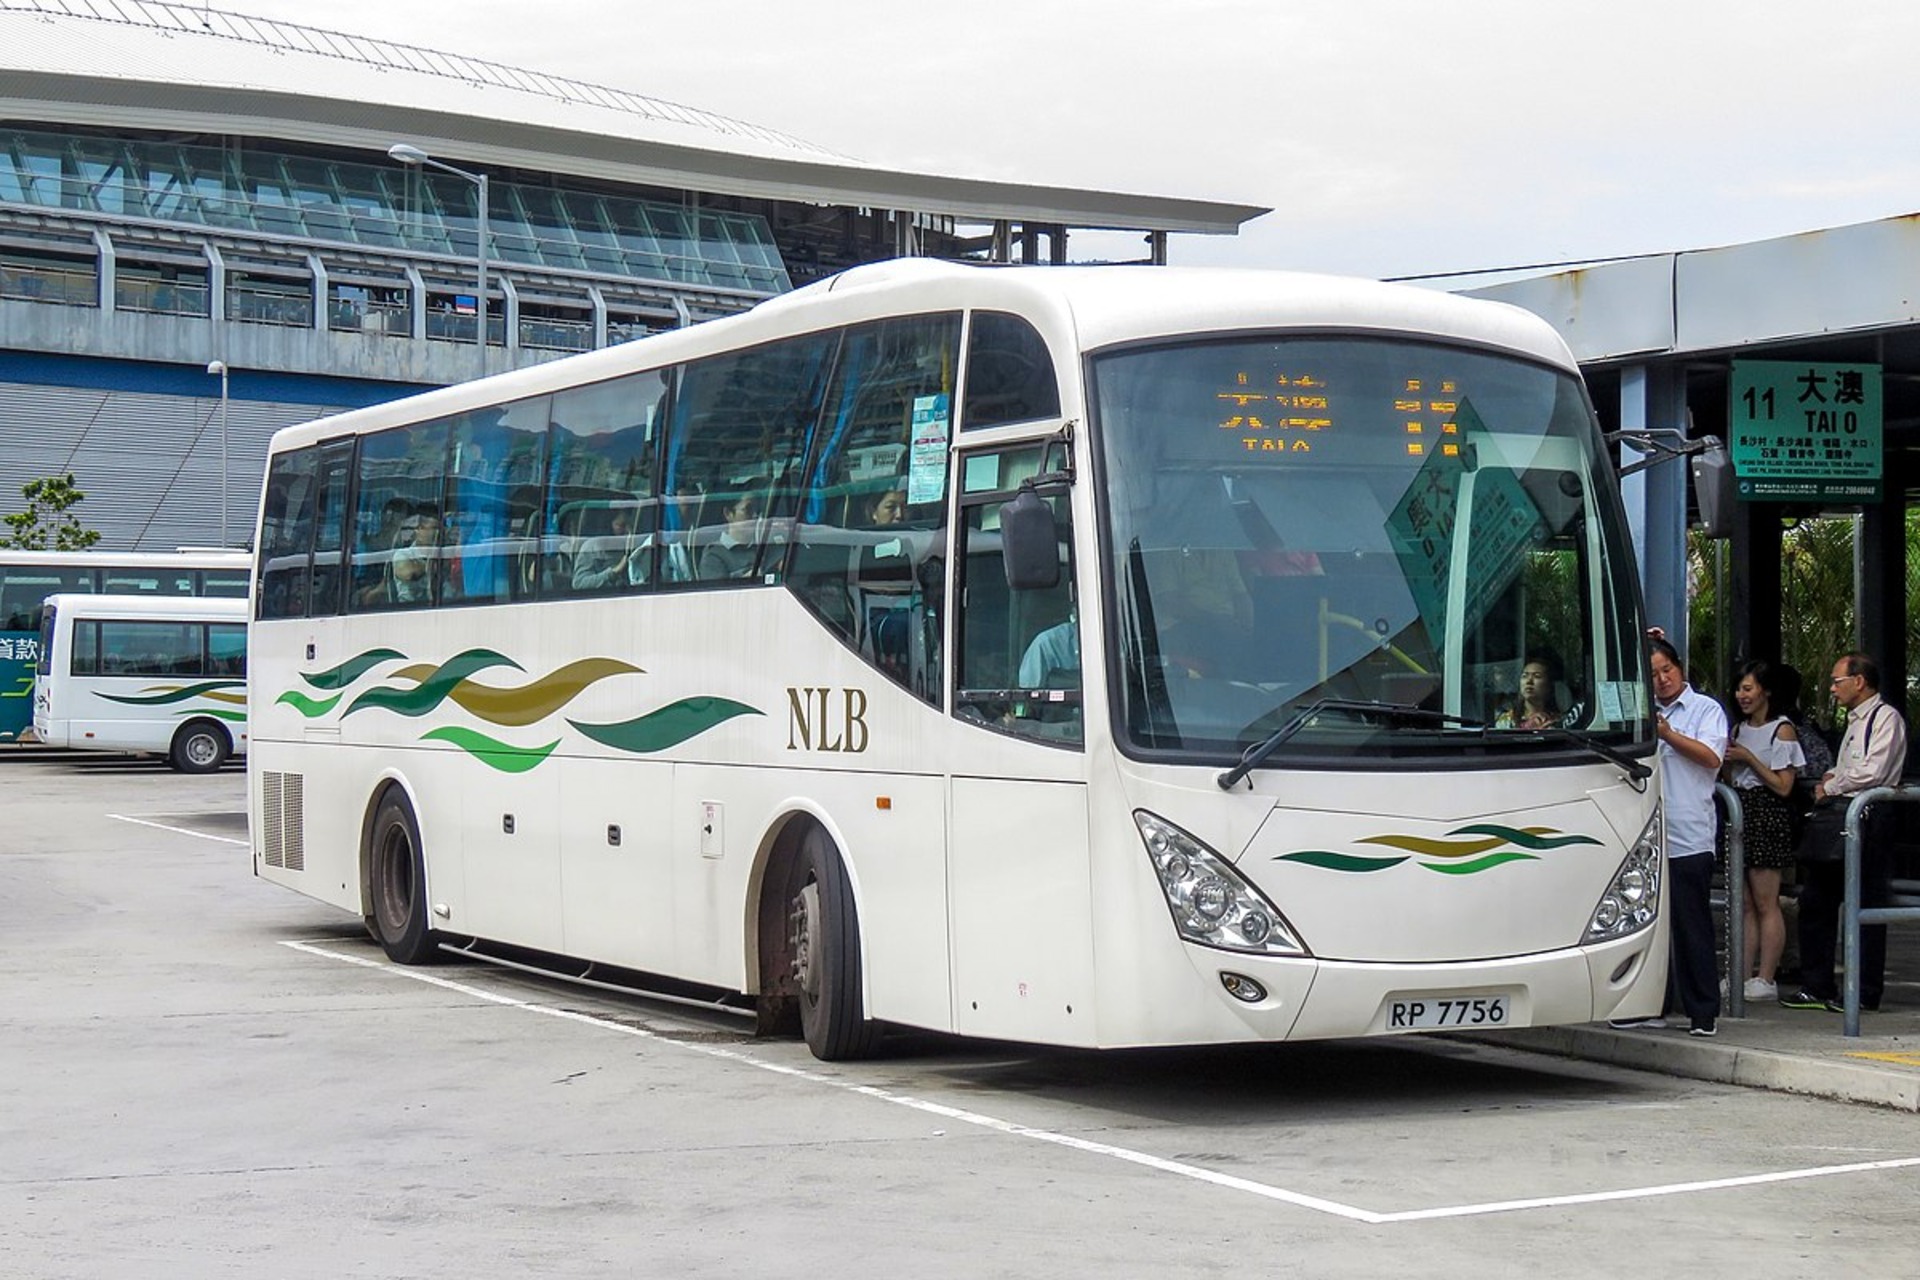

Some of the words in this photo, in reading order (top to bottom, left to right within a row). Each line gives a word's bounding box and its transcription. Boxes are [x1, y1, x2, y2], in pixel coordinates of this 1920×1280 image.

[1743, 386, 1775, 420] 11
[1797, 369, 1864, 405] 大澳
[1805, 411, 1837, 433] TAI
[1844, 411, 1857, 434] O
[786, 687, 869, 753] NLB
[1391, 1003, 1425, 1026] RP
[1438, 1000, 1504, 1025] 7756
